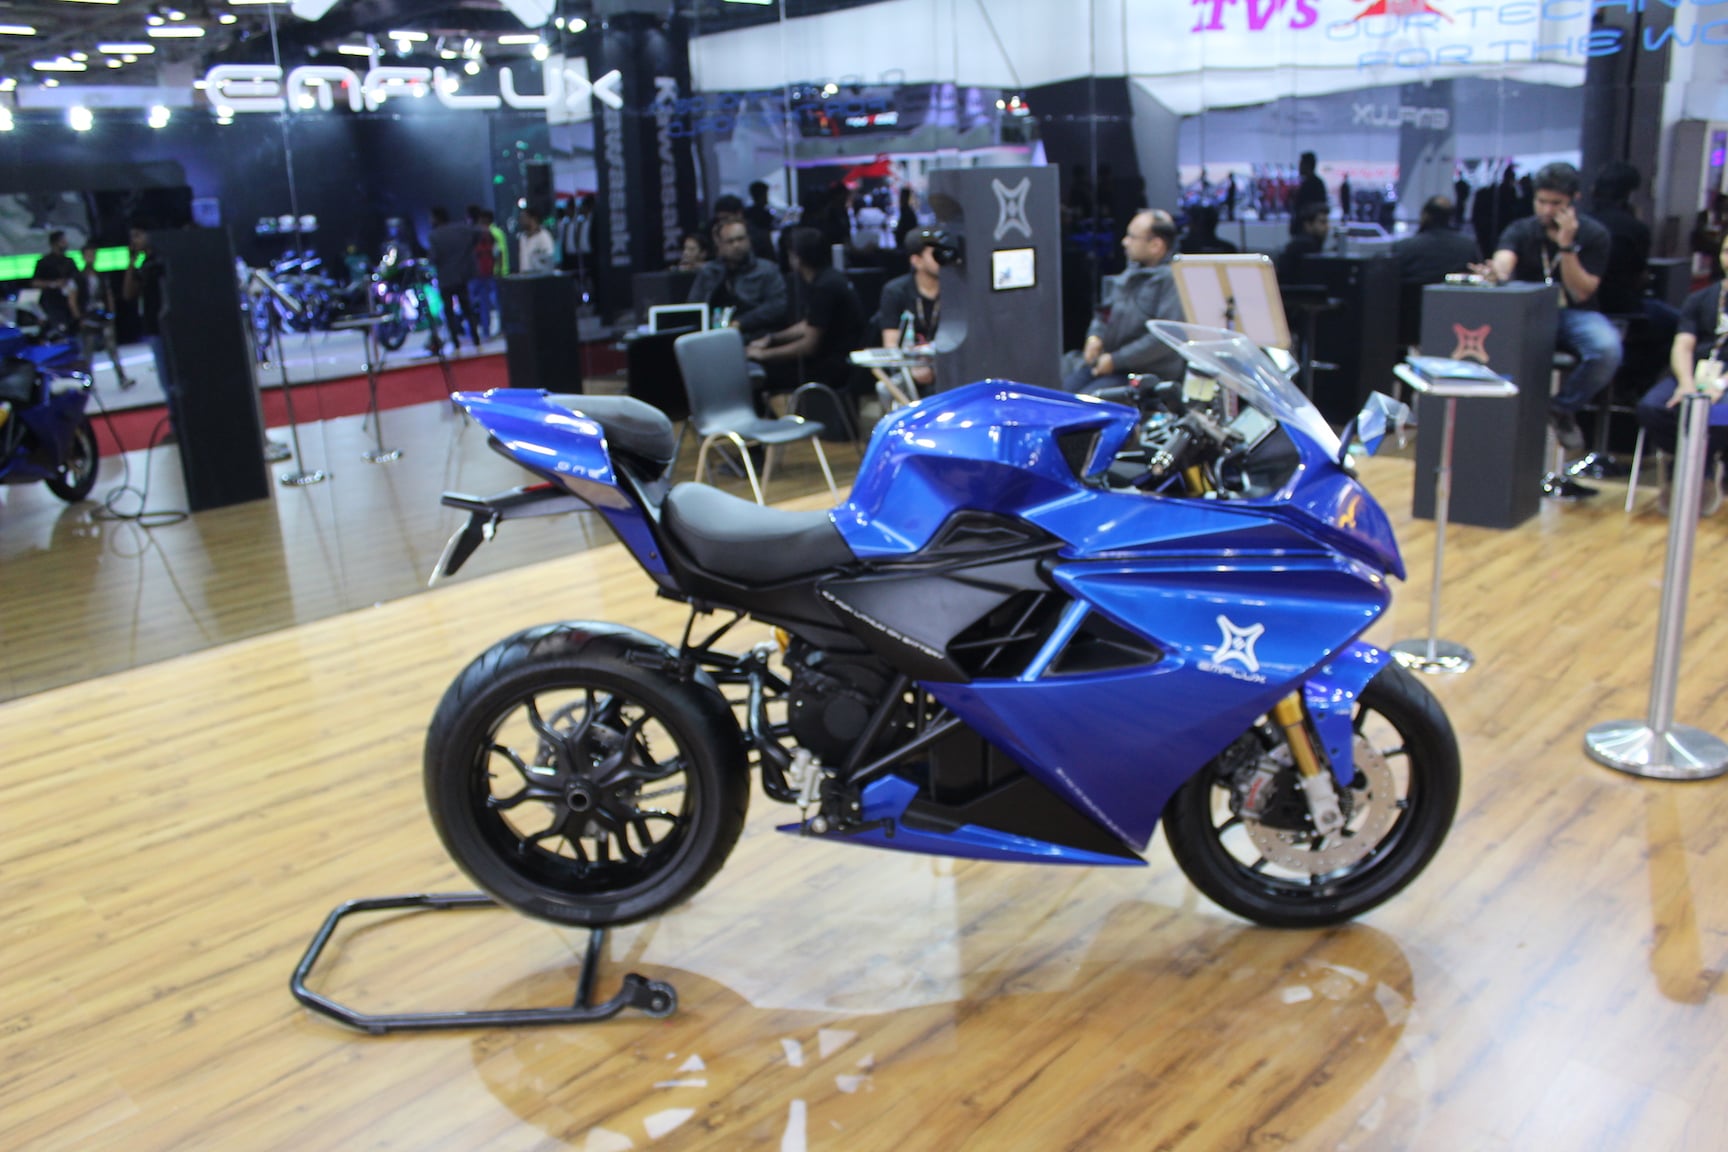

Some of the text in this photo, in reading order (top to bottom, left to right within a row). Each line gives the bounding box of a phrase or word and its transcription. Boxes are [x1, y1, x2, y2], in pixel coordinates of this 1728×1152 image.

[1191, 0, 1319, 32] TVS
[1325, 12, 1441, 40] OUR
[1358, 44, 1474, 69] FOR
[1488, 28, 1624, 62] THE
